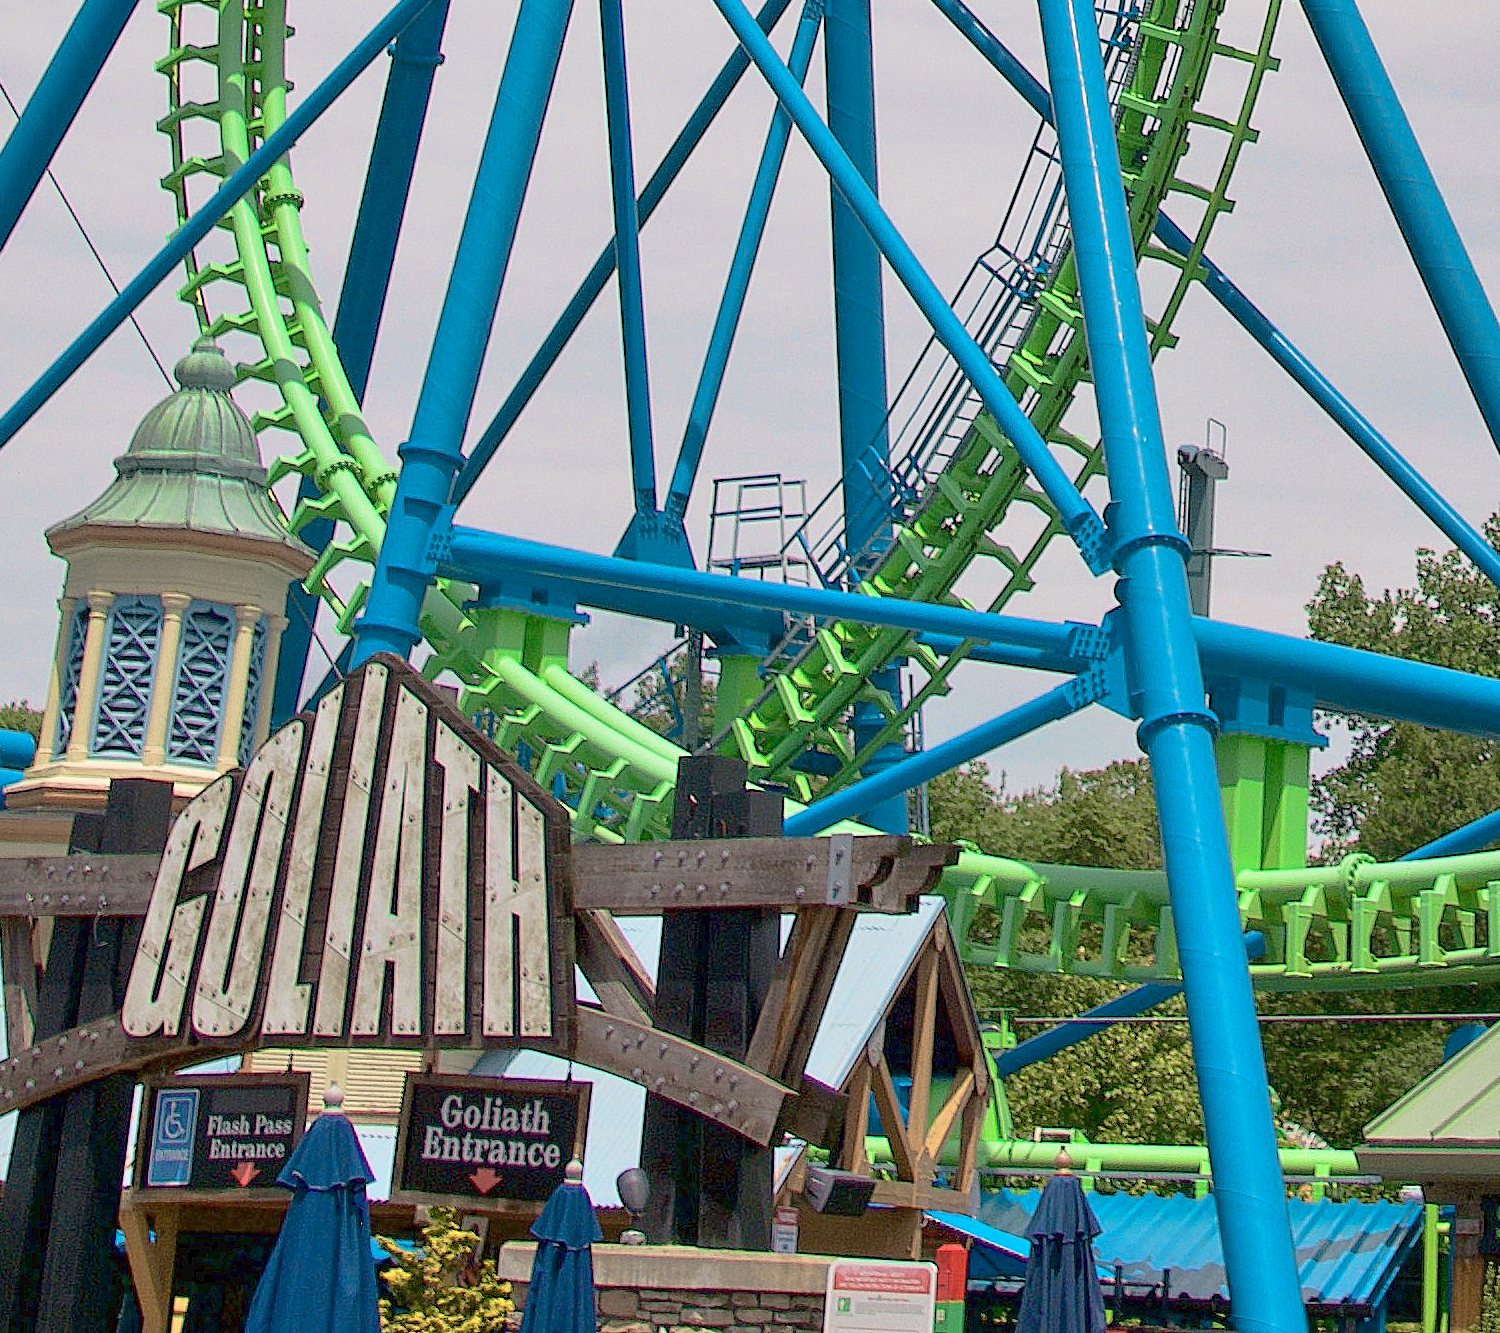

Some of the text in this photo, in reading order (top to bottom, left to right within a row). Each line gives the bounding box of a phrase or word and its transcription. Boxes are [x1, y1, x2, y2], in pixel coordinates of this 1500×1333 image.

[121, 661, 553, 1038] GOLIATH
[207, 1113, 293, 1135] Flash Pass
[440, 1094, 550, 1134] Goliath
[210, 1137, 286, 1159] Entrance
[421, 1124, 561, 1169] Entrance
